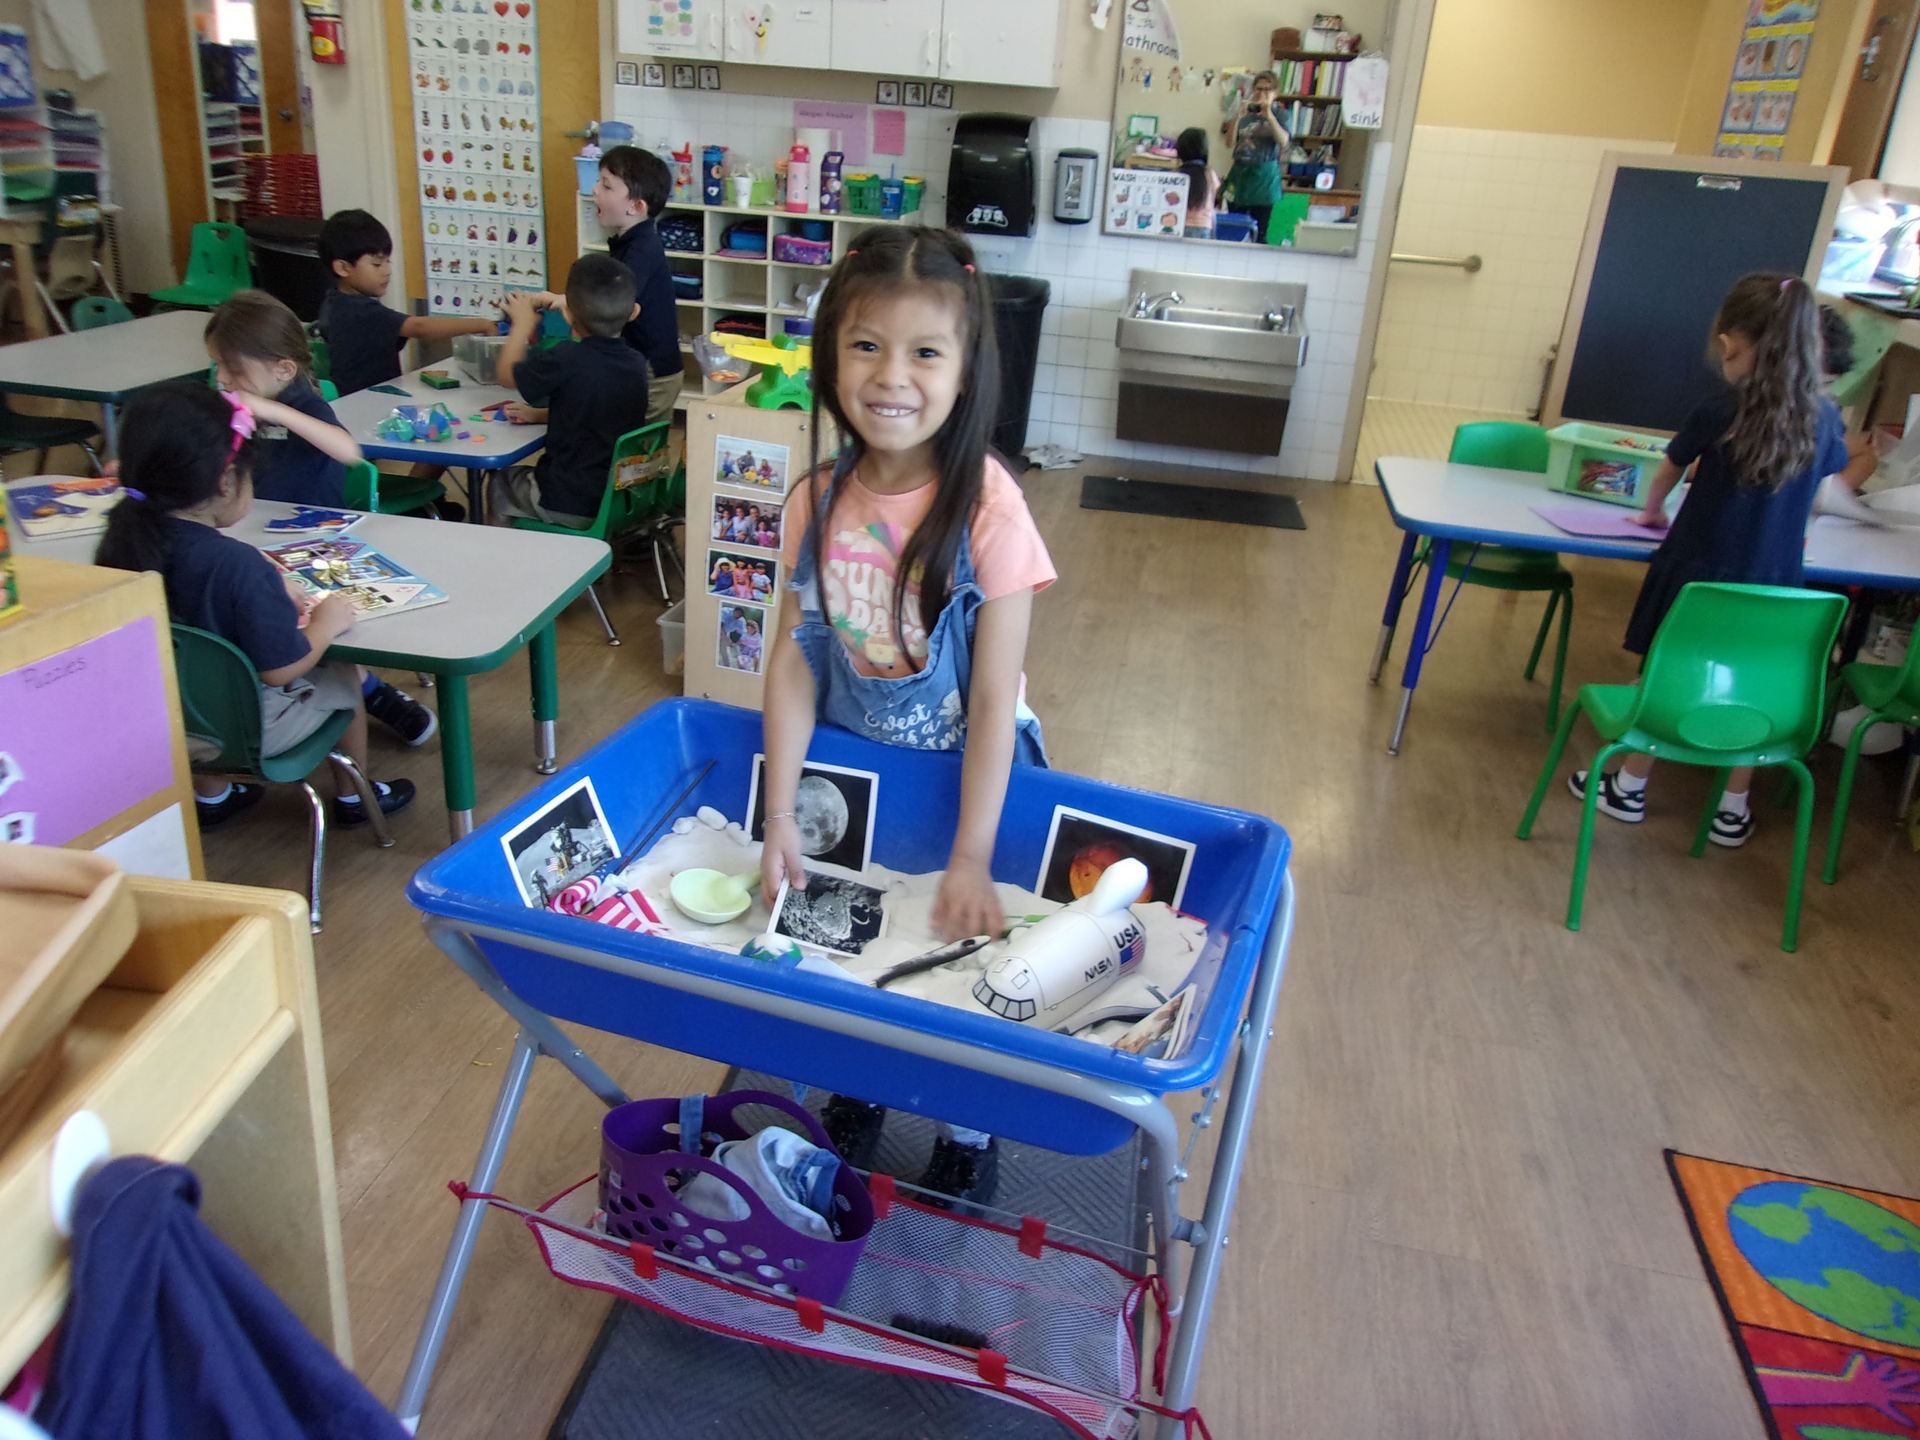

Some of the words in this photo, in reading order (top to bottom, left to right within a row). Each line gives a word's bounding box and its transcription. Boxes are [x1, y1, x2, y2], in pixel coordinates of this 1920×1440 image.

[1124, 34, 1180, 61] athroom
[1350, 111, 1380, 126] sink
[1112, 172, 1136, 182] WASH
[1157, 175, 1187, 187] HANDS
[21, 657, 88, 692] Puzzles
[1113, 923, 1140, 949] USA
[1084, 957, 1113, 982] NASA
